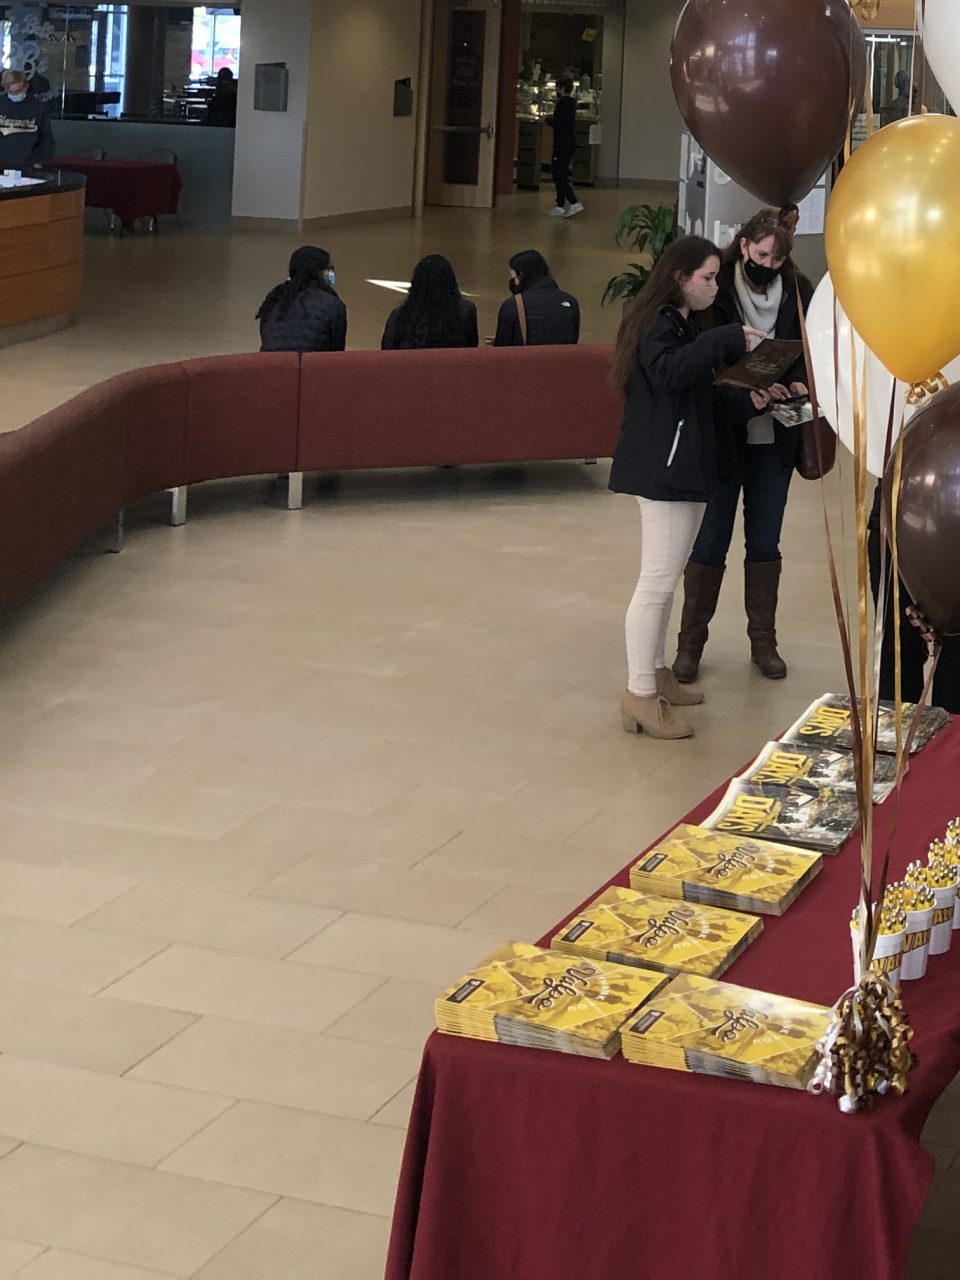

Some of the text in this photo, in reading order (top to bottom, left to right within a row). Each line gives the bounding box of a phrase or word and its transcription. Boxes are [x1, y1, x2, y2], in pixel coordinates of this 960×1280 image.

[799, 706, 851, 736] DAYS
[751, 751, 807, 784] DAYS
[715, 794, 775, 832] DAYS
[706, 843, 760, 879] Valpo
[633, 907, 696, 948] Valpo
[527, 967, 596, 1011] Valpo
